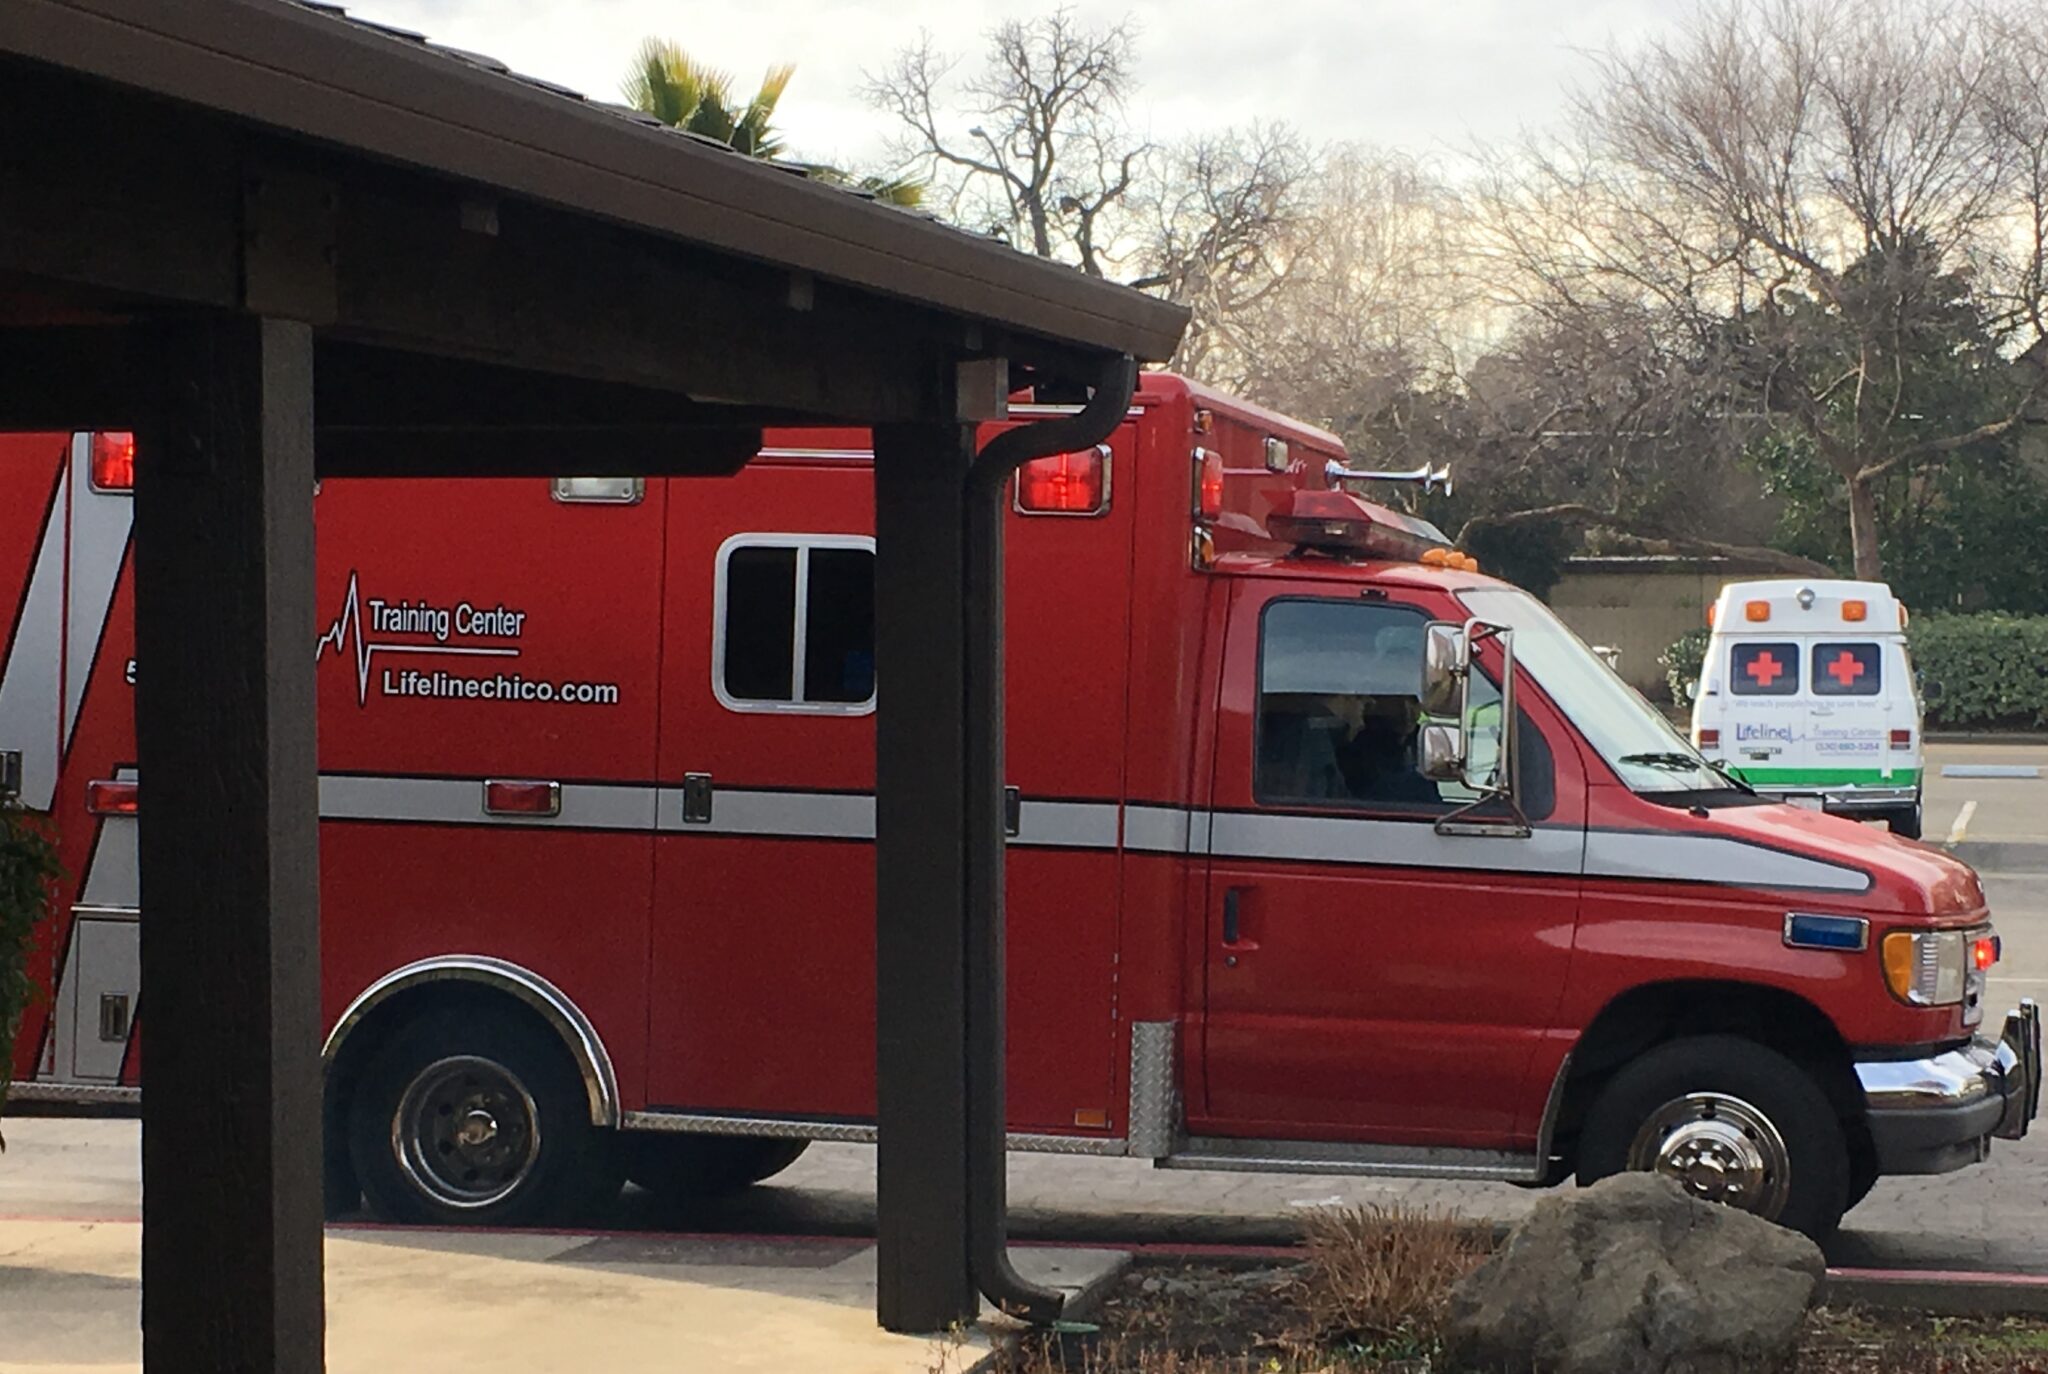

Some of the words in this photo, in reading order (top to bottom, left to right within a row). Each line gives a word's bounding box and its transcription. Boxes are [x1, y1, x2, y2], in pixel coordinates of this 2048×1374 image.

[369, 599, 449, 641] Training
[454, 602, 526, 637] Center
[383, 670, 619, 704] Lifelinechico.com
[1736, 722, 1789, 741] Lifeline
